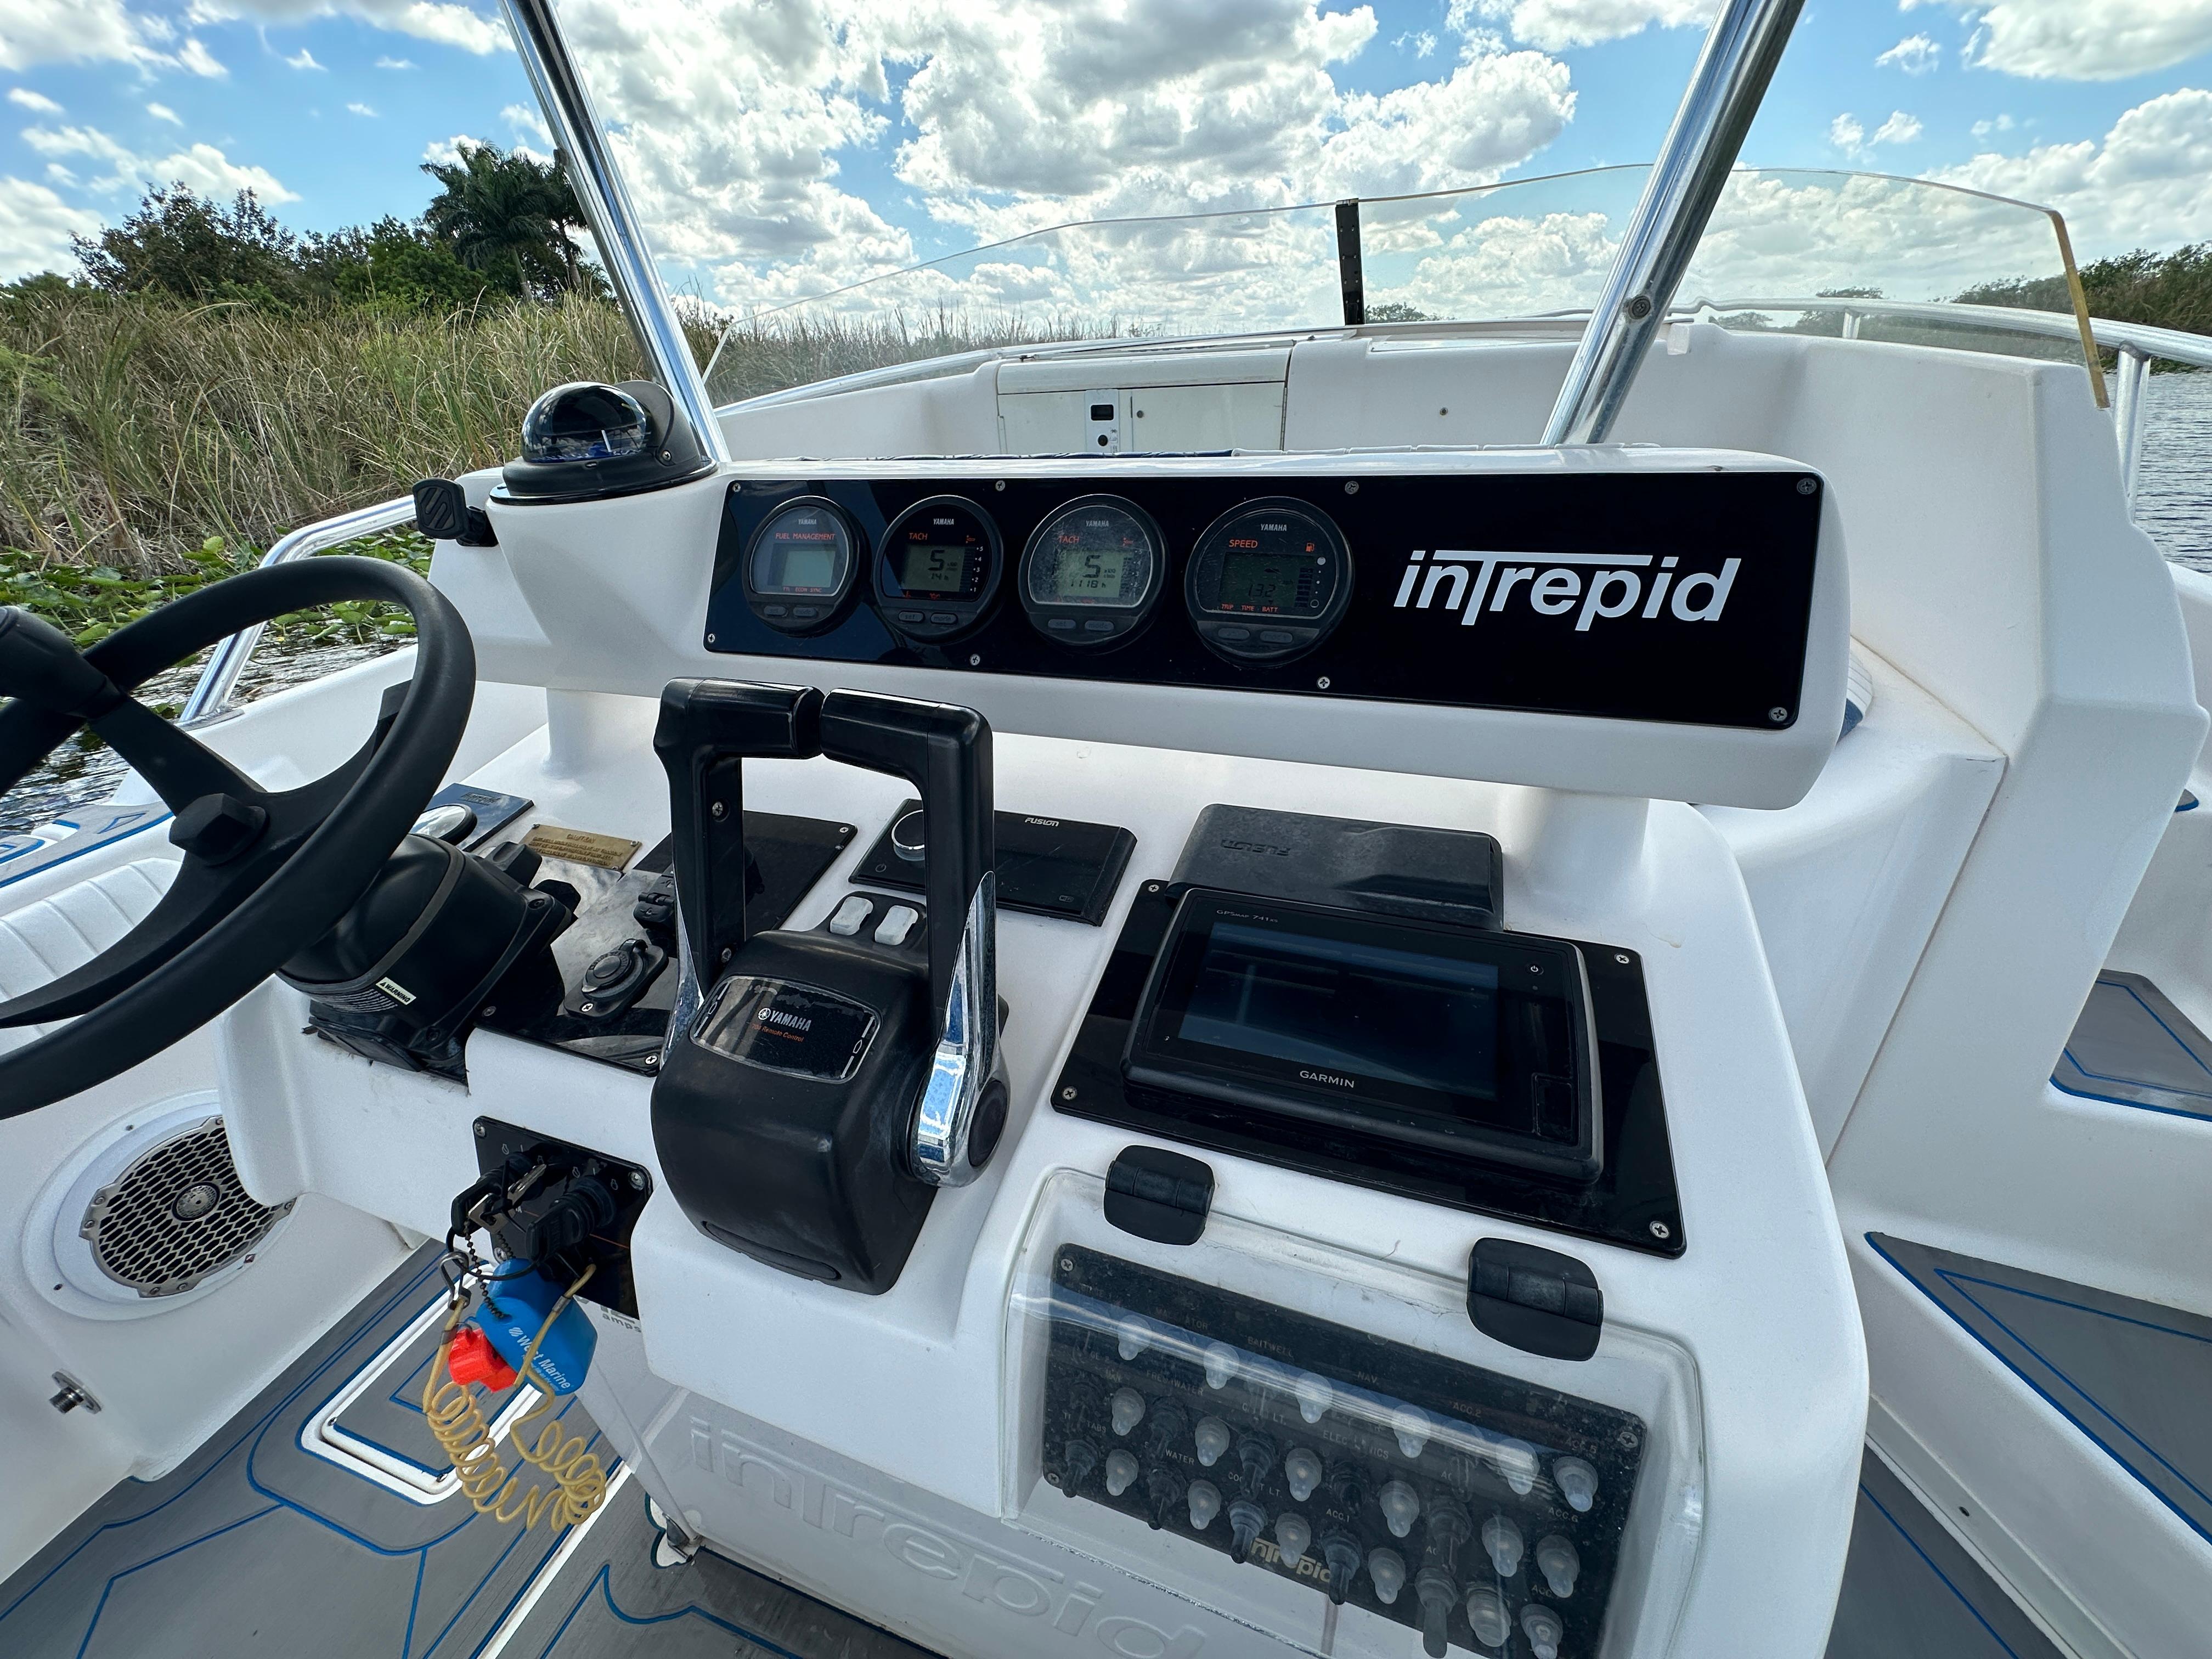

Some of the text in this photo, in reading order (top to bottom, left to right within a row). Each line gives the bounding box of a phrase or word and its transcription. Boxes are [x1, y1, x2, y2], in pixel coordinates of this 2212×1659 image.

[909, 532, 928, 540] TACH
[1261, 523, 1287, 532] YAMAHA
[1059, 535, 1080, 544] TACH
[1228, 539, 1258, 549] SPEED
[928, 550, 945, 571] 5
[1082, 555, 1101, 578] 5
[385, 983, 411, 1002] WARNING
[770, 1010, 812, 1031] YAMAHA
[761, 1026, 782, 1036] Remote
[783, 1032, 805, 1042] Control
[1300, 1070, 1355, 1088] GARMIN
[602, 1313, 642, 1333] amps
[1247, 1336, 1294, 1357] BAITWELL
[517, 1335, 544, 1360] Wet
[538, 1358, 571, 1389] Marine
[1322, 1429, 1389, 1460] ELECNICS
[1165, 1449, 1195, 1465] WATER
[1326, 1508, 1350, 1523] ACC.1
[1548, 1507, 1578, 1523] ACC.6
